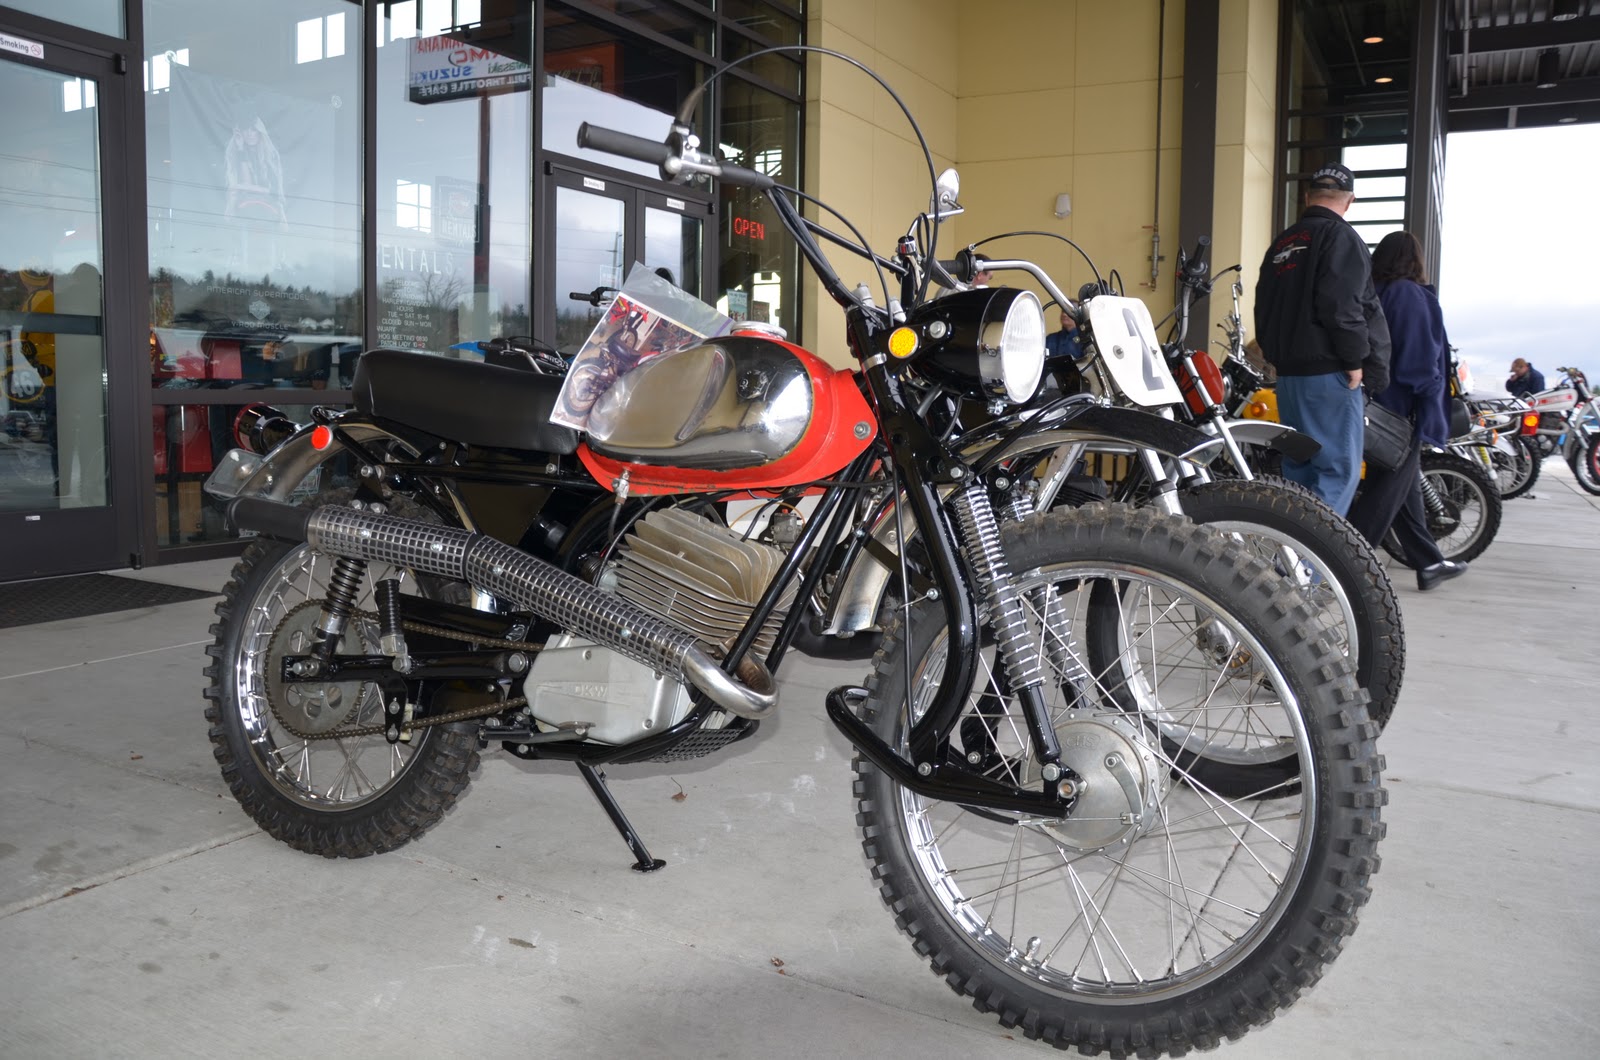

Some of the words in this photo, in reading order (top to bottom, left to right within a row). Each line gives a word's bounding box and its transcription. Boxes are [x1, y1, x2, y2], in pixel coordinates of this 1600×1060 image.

[0, 37, 29, 53] Smoking
[733, 217, 765, 240] OPEN
[377, 241, 454, 276] ENTALS
[207, 285, 251, 296] AMERICAN
[253, 289, 310, 300] SUPERMODEL
[1122, 307, 1165, 392] 2
[575, 684, 608, 698] DKW
[1060, 734, 1094, 750] ACHS
